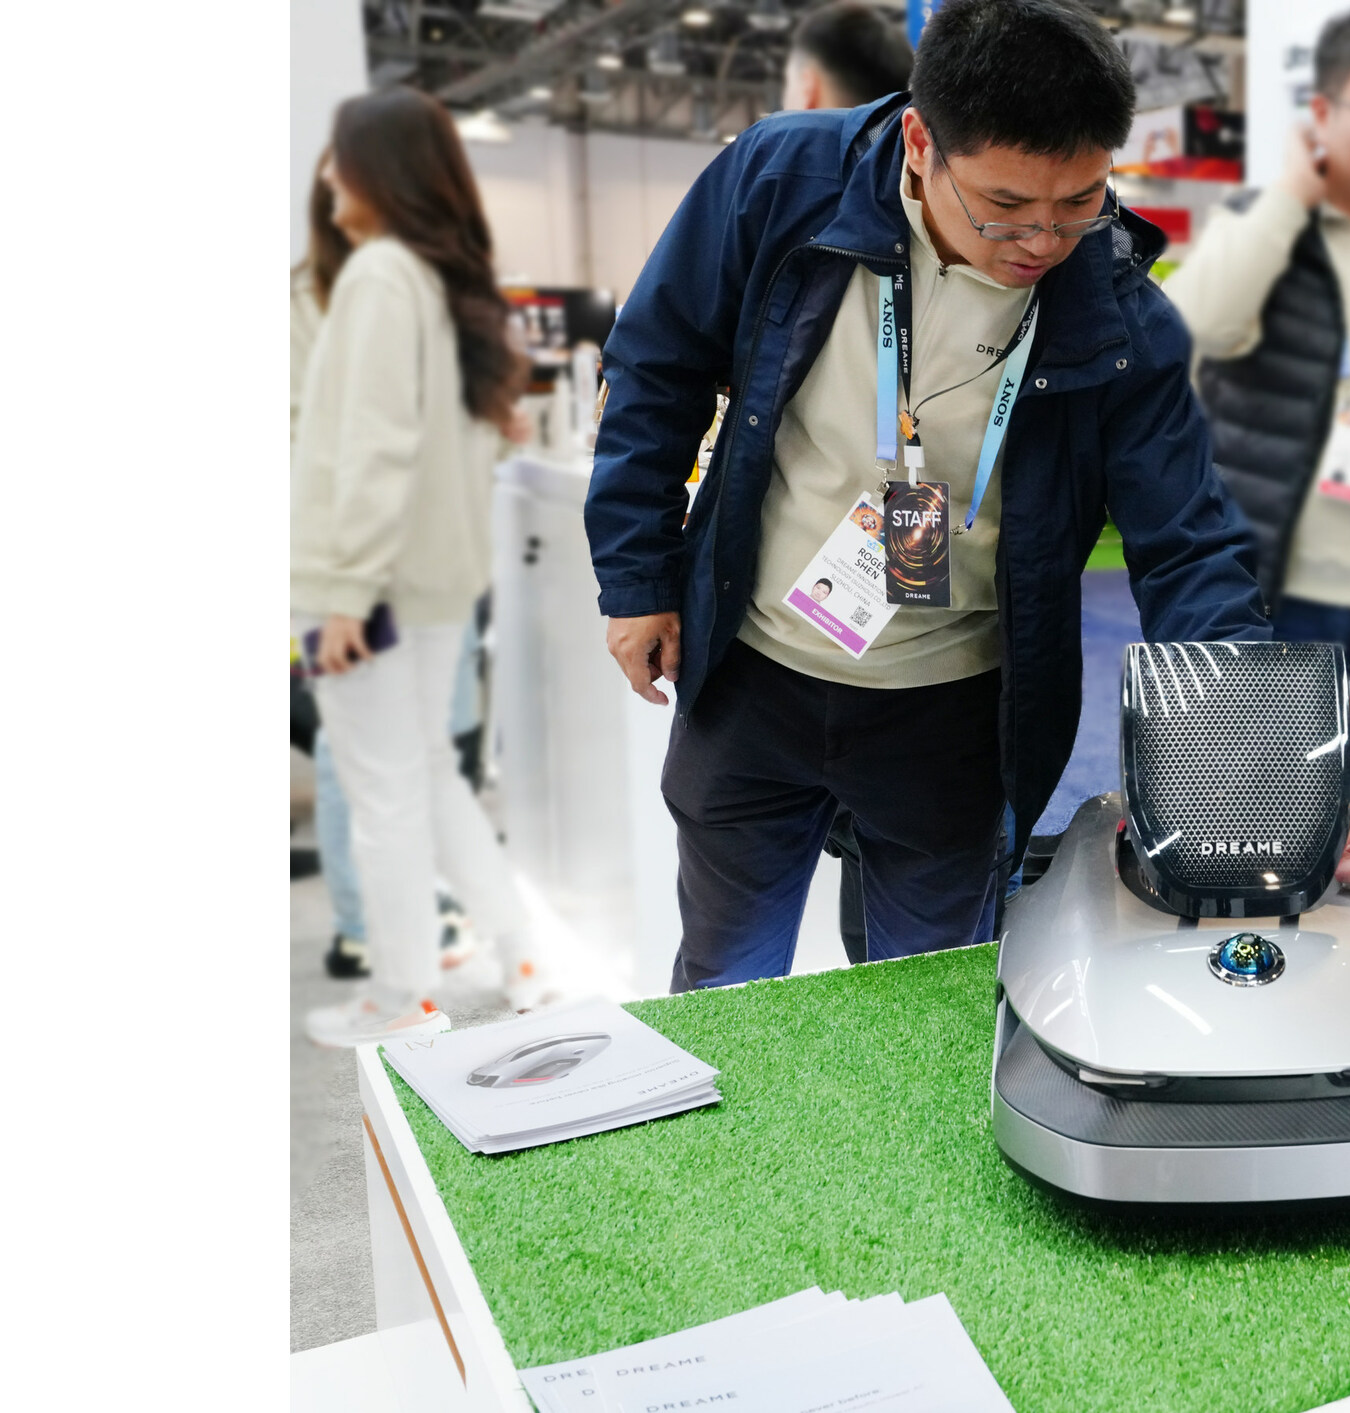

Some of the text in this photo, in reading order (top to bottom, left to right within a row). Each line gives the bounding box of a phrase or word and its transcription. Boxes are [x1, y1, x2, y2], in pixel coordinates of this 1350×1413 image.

[882, 298, 894, 348] SONY
[900, 328, 909, 374] DREAME
[976, 344, 1004, 357] DRE
[993, 378, 1015, 427] SONY
[892, 509, 942, 528] STAFF
[854, 558, 880, 580] SHEN
[858, 547, 887, 575] ROGER
[852, 590, 872, 607] CHINA
[905, 592, 931, 600] DREAME
[811, 608, 844, 635] EXHIBITOR
[1201, 841, 1282, 855] DREAME
[637, 1071, 700, 1096] DREAME
[543, 1368, 588, 1383] DRE
[616, 1356, 707, 1377] DREAME
[646, 1391, 738, 1413] DREAME
